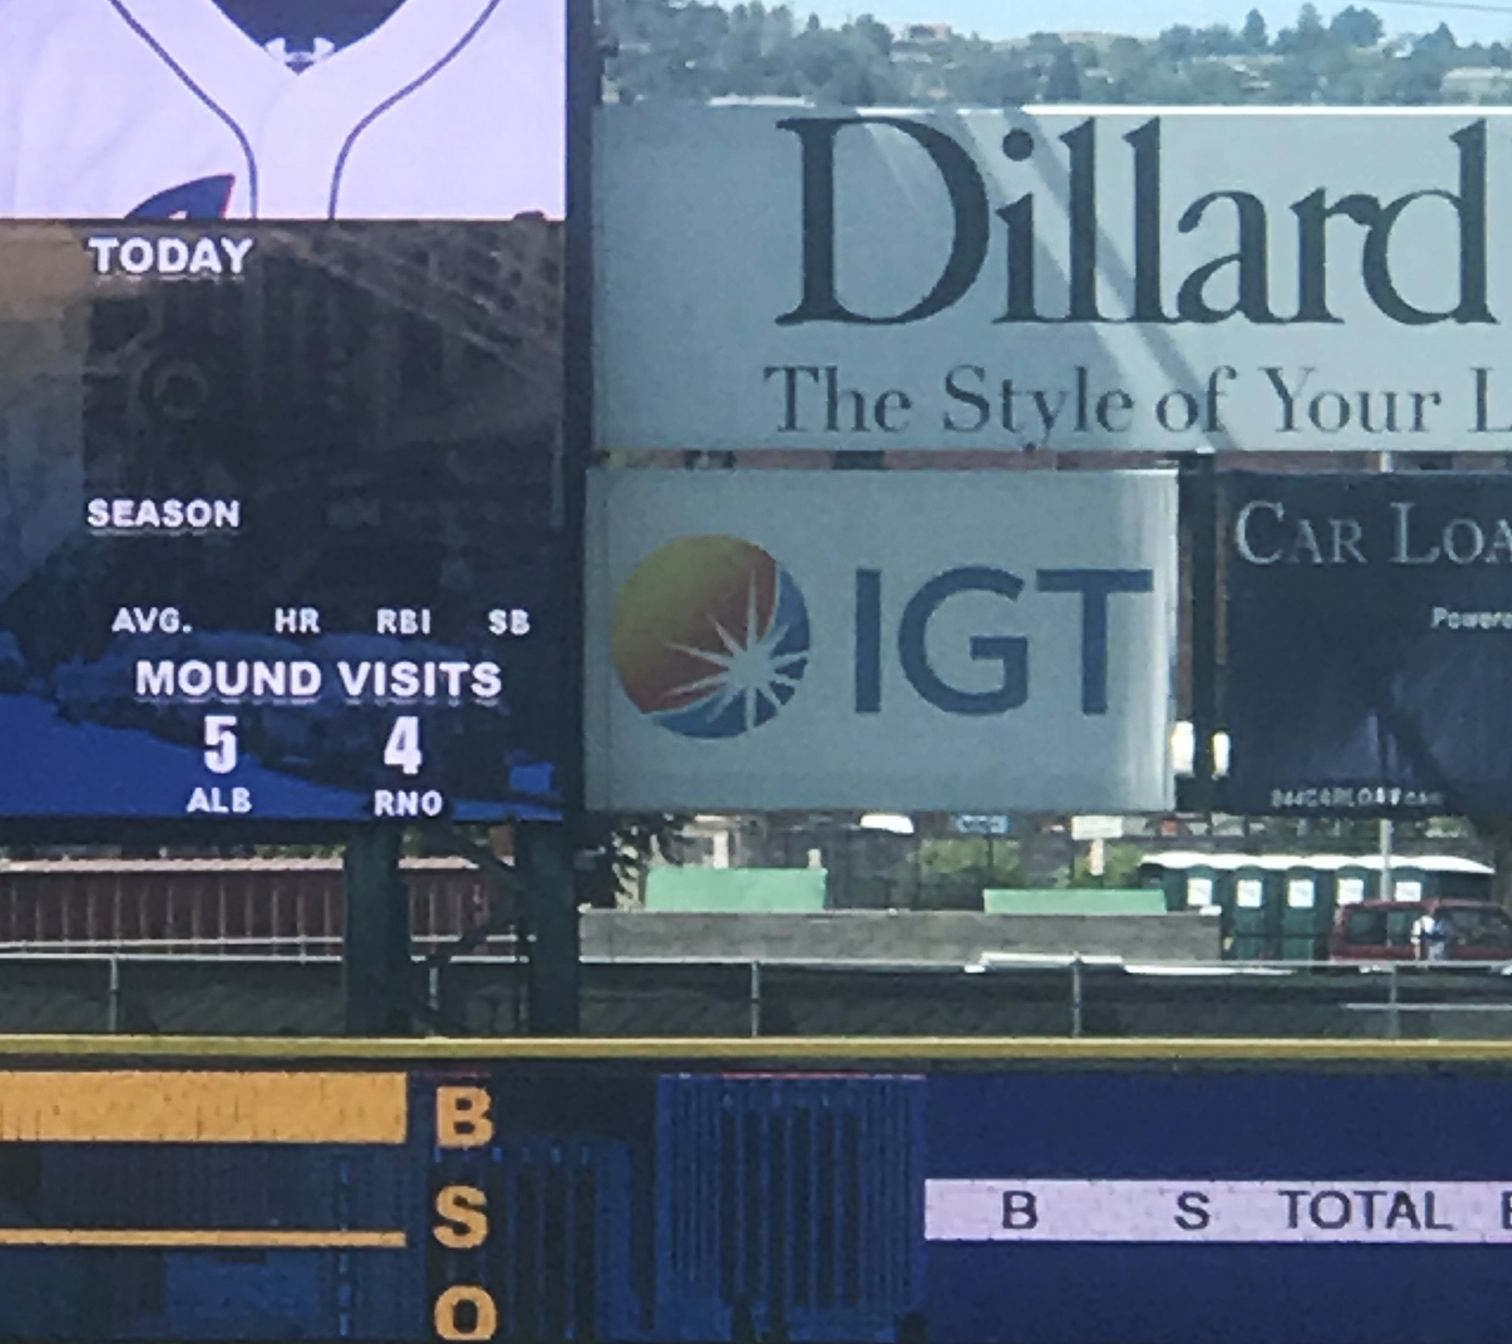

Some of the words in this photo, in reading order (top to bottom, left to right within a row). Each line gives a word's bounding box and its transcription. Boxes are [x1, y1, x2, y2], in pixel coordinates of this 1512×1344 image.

[774, 116, 1501, 325] Dillard
[88, 237, 254, 274] TODAY
[764, 364, 913, 433] The
[942, 364, 1133, 452] Style
[1155, 364, 1237, 434] of
[1256, 366, 1443, 434] Your
[87, 498, 241, 528] SEASON
[1235, 500, 1368, 565] CAR
[111, 607, 192, 634] AVG.
[274, 607, 321, 634] HR
[376, 608, 431, 634] RBI
[488, 608, 531, 635] SB
[854, 566, 1154, 716] IGT
[135, 660, 322, 697] MOUND
[337, 660, 502, 698] VISITS
[203, 714, 238, 774] 5
[383, 716, 423, 775] 4
[186, 786, 253, 814] ALB
[373, 789, 443, 817] RNO
[435, 1085, 496, 1148] B
[433, 1184, 488, 1249] S
[1002, 1190, 1038, 1229] B
[1174, 1190, 1211, 1230] S
[1277, 1190, 1455, 1230] TOTAL
